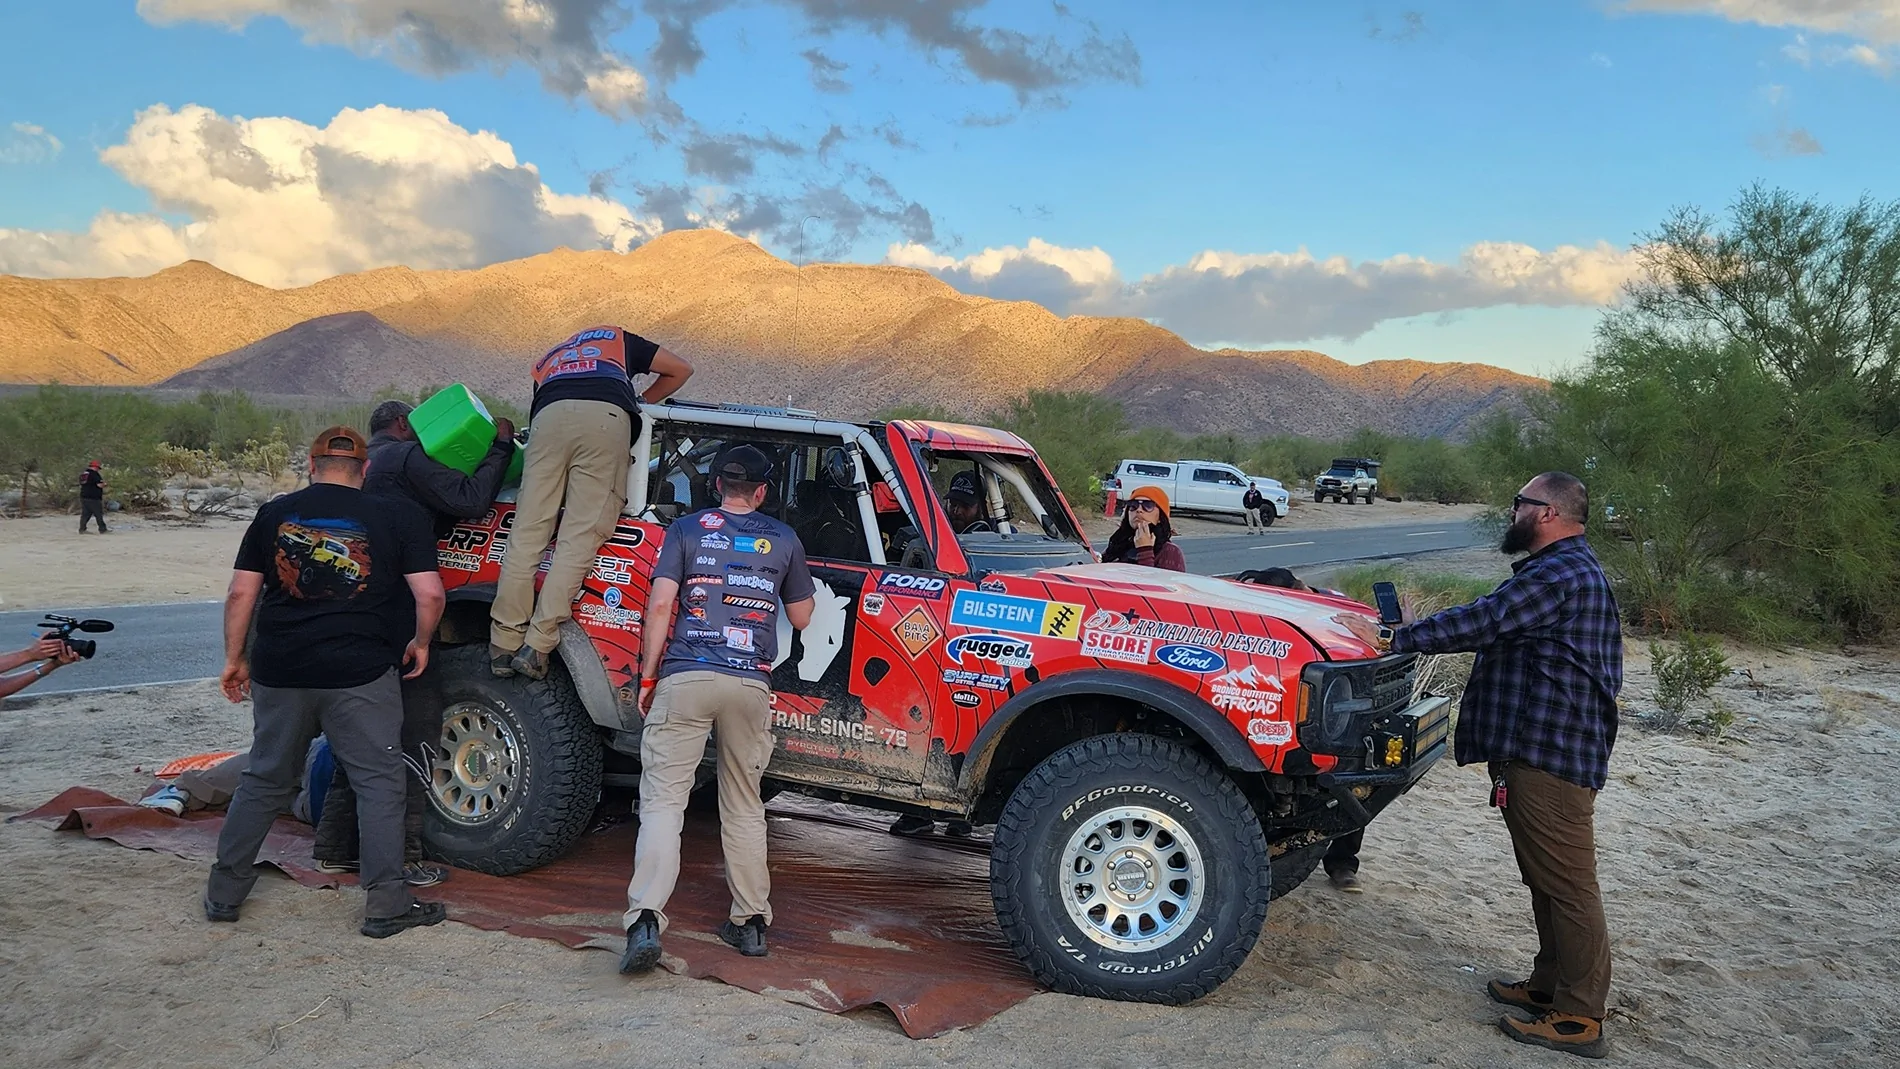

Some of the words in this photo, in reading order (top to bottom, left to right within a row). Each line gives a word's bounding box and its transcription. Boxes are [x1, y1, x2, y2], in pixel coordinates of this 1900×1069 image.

[878, 585, 939, 598] PERFORMANCE
[881, 573, 945, 591] FORD
[580, 603, 595, 614] GO
[595, 605, 642, 621] PLUMBING
[962, 599, 1035, 623] BILSTEIN
[904, 631, 929, 642] PITS
[1086, 632, 1148, 655] SCORE
[1132, 619, 1222, 648] ARMADILLO
[1222, 632, 1292, 660] DESIGNS
[1085, 647, 1146, 658] INTERNATIONAL
[1167, 646, 1213, 671] Ford
[943, 669, 980, 683] SURF
[980, 673, 1010, 691] CITY
[1211, 684, 1241, 696] BRONCO
[1241, 689, 1283, 702] OUTFITTERS
[1212, 694, 1277, 715] OFFROAD
[769, 709, 816, 733] TRAIL
[820, 717, 875, 742] SINCE
[1061, 784, 1195, 821] BFGoodrich
[1057, 935, 1089, 963] T/A
[1098, 927, 1215, 974] All-Terrain
